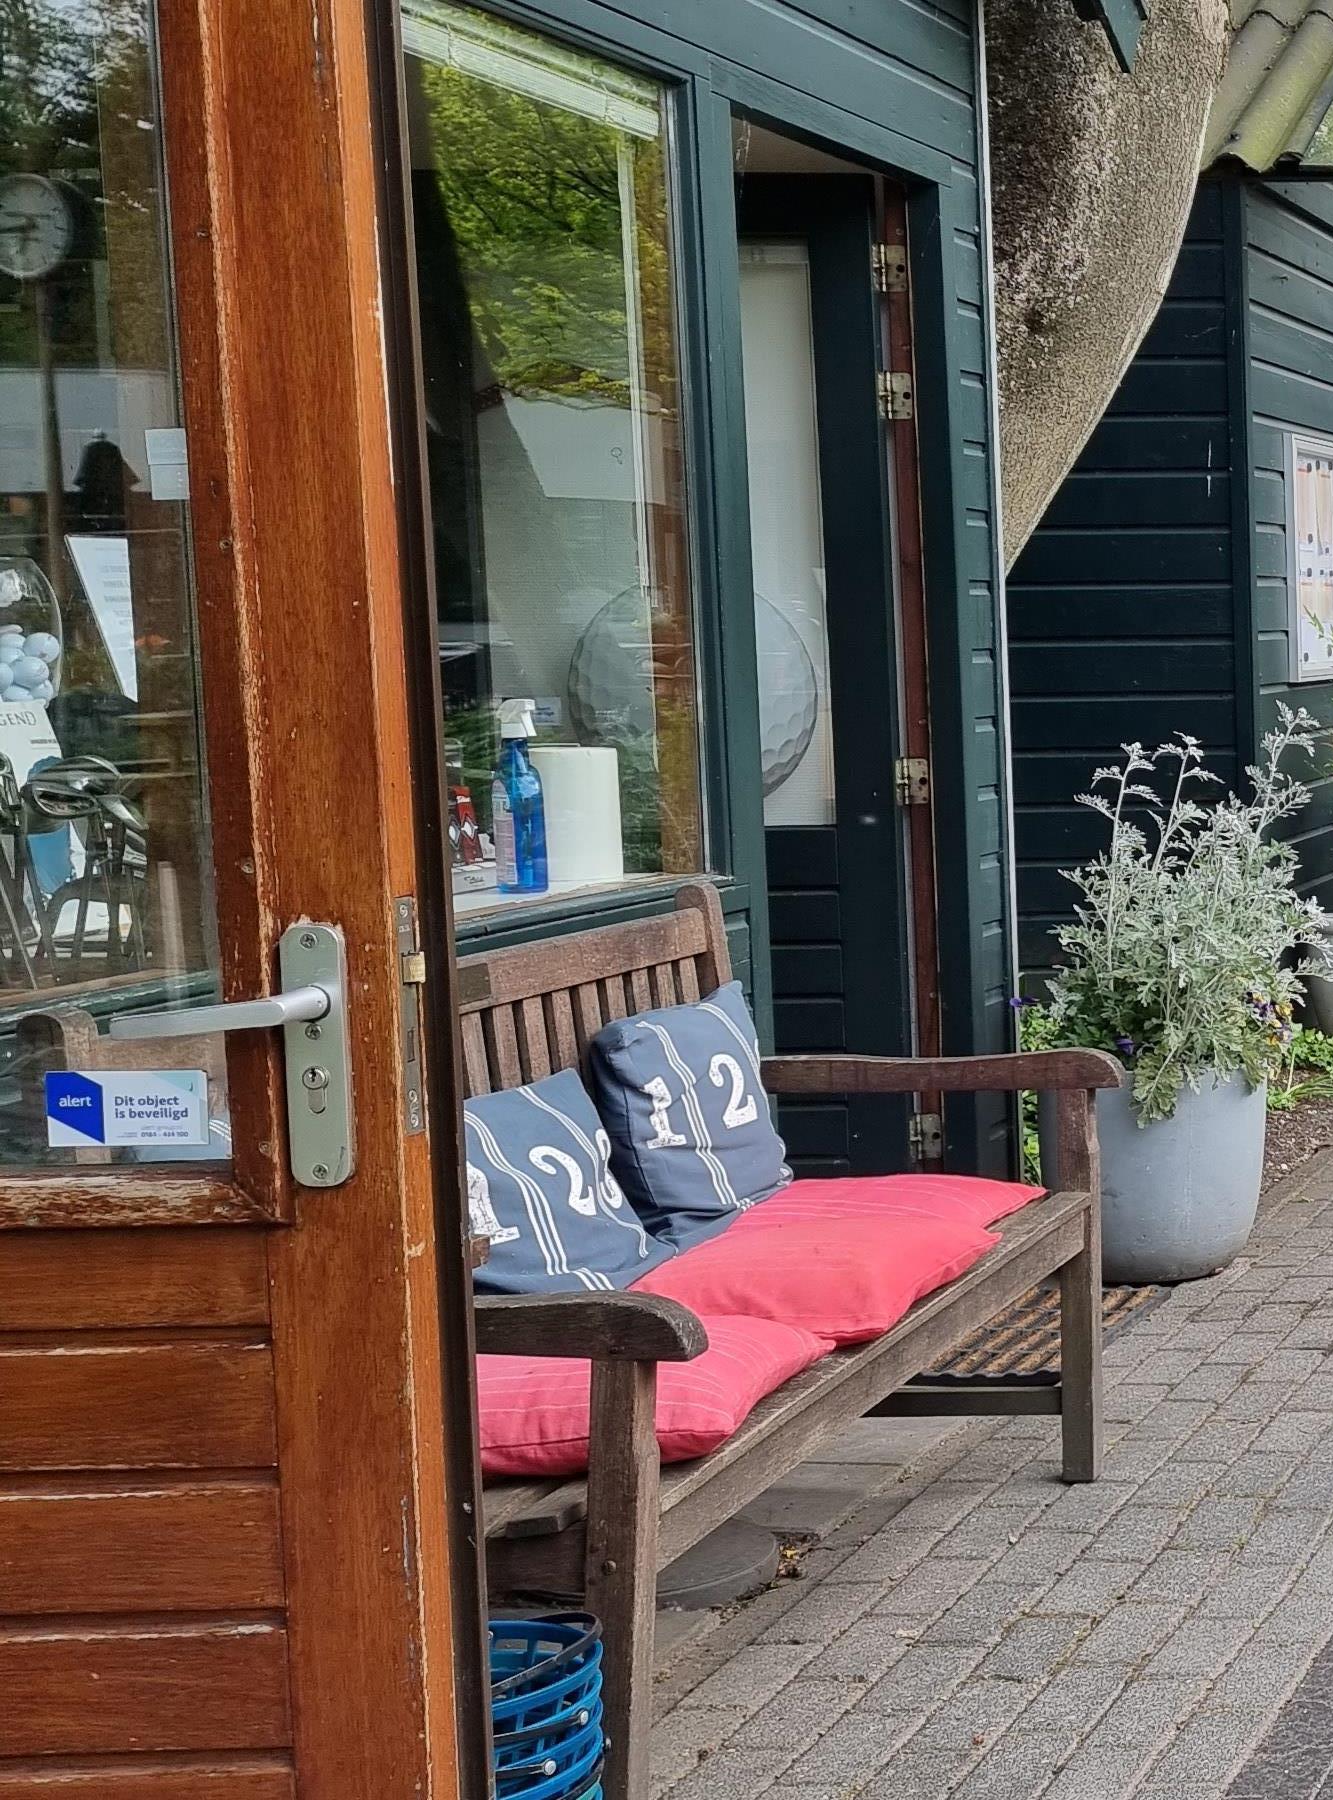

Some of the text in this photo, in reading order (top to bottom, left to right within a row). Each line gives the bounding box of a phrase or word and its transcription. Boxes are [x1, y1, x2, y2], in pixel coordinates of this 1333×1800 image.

[708, 1053, 758, 1129] 2
[58, 1094, 93, 1107] alert
[114, 1095, 180, 1109] Dit object
[114, 1107, 189, 1121] is beveiligd
